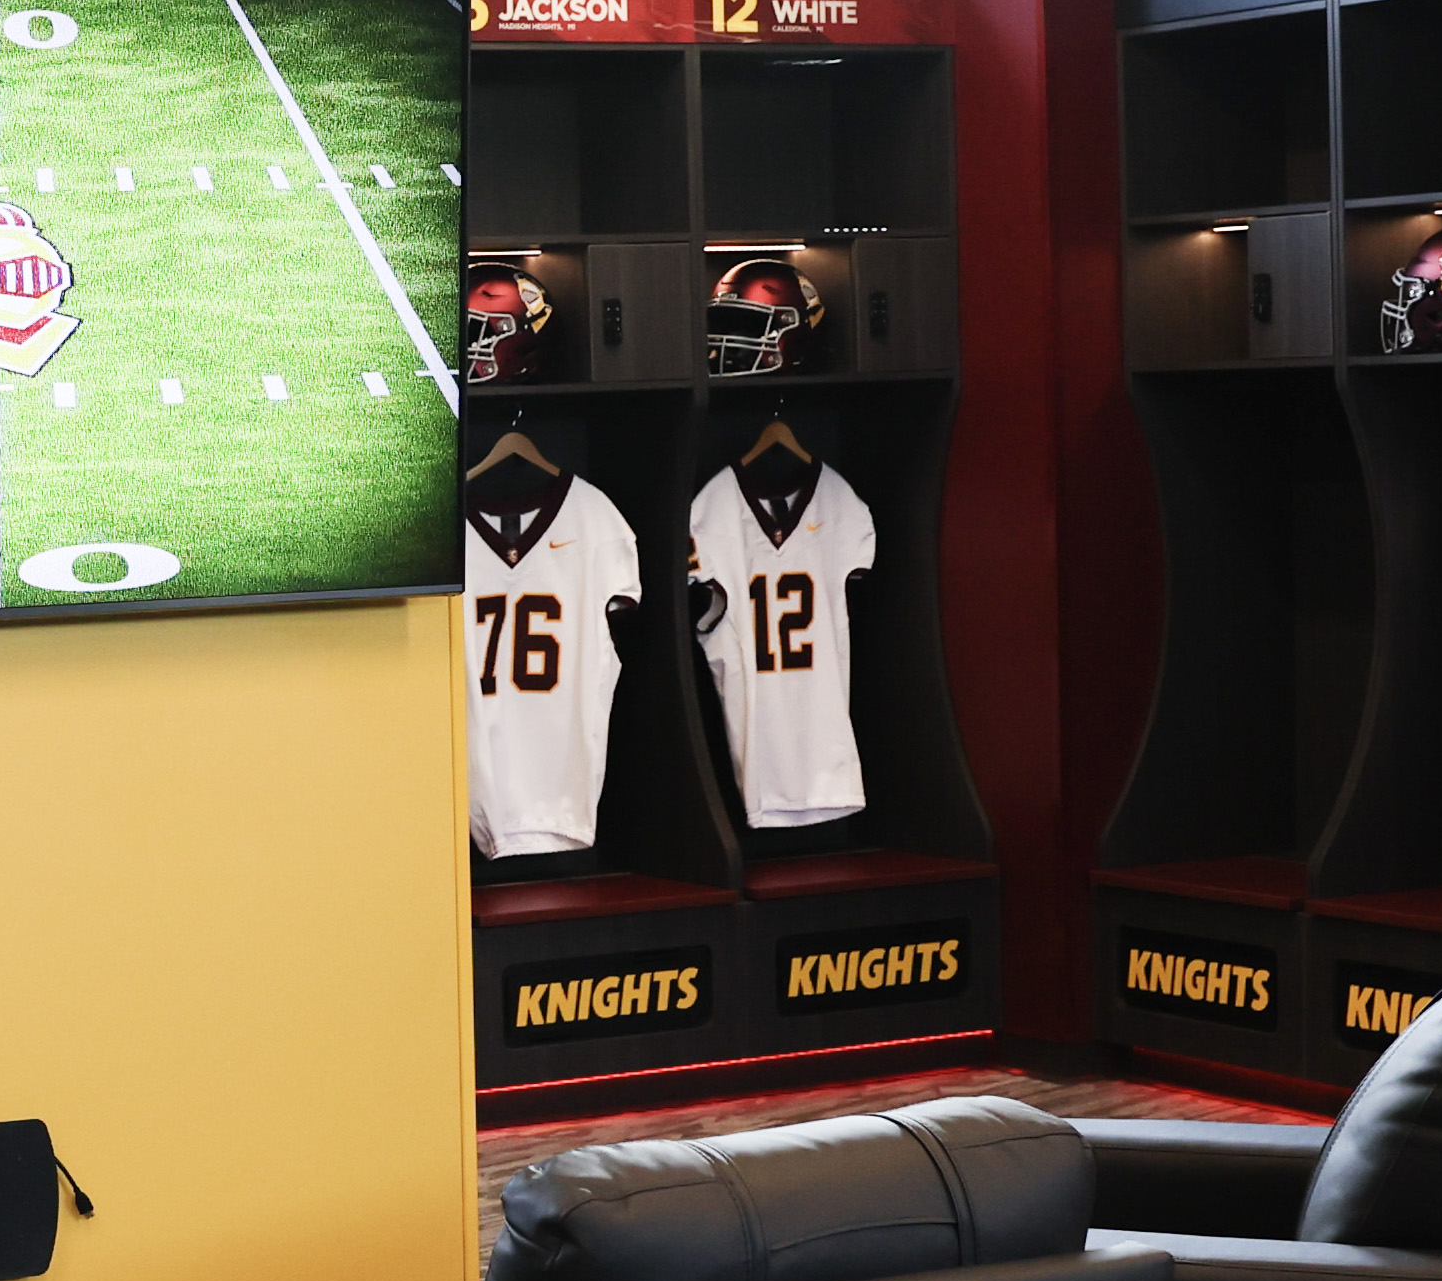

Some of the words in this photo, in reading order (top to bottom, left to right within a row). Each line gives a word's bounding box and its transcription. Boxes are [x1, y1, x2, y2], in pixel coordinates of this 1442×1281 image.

[772, 0, 858, 24] WHITE
[475, 592, 563, 697] 76
[748, 570, 815, 673] 12
[515, 966, 700, 1029] KNIGHTS
[787, 939, 961, 998] KNIGHTS
[1126, 947, 1271, 1012] KNIGHTS
